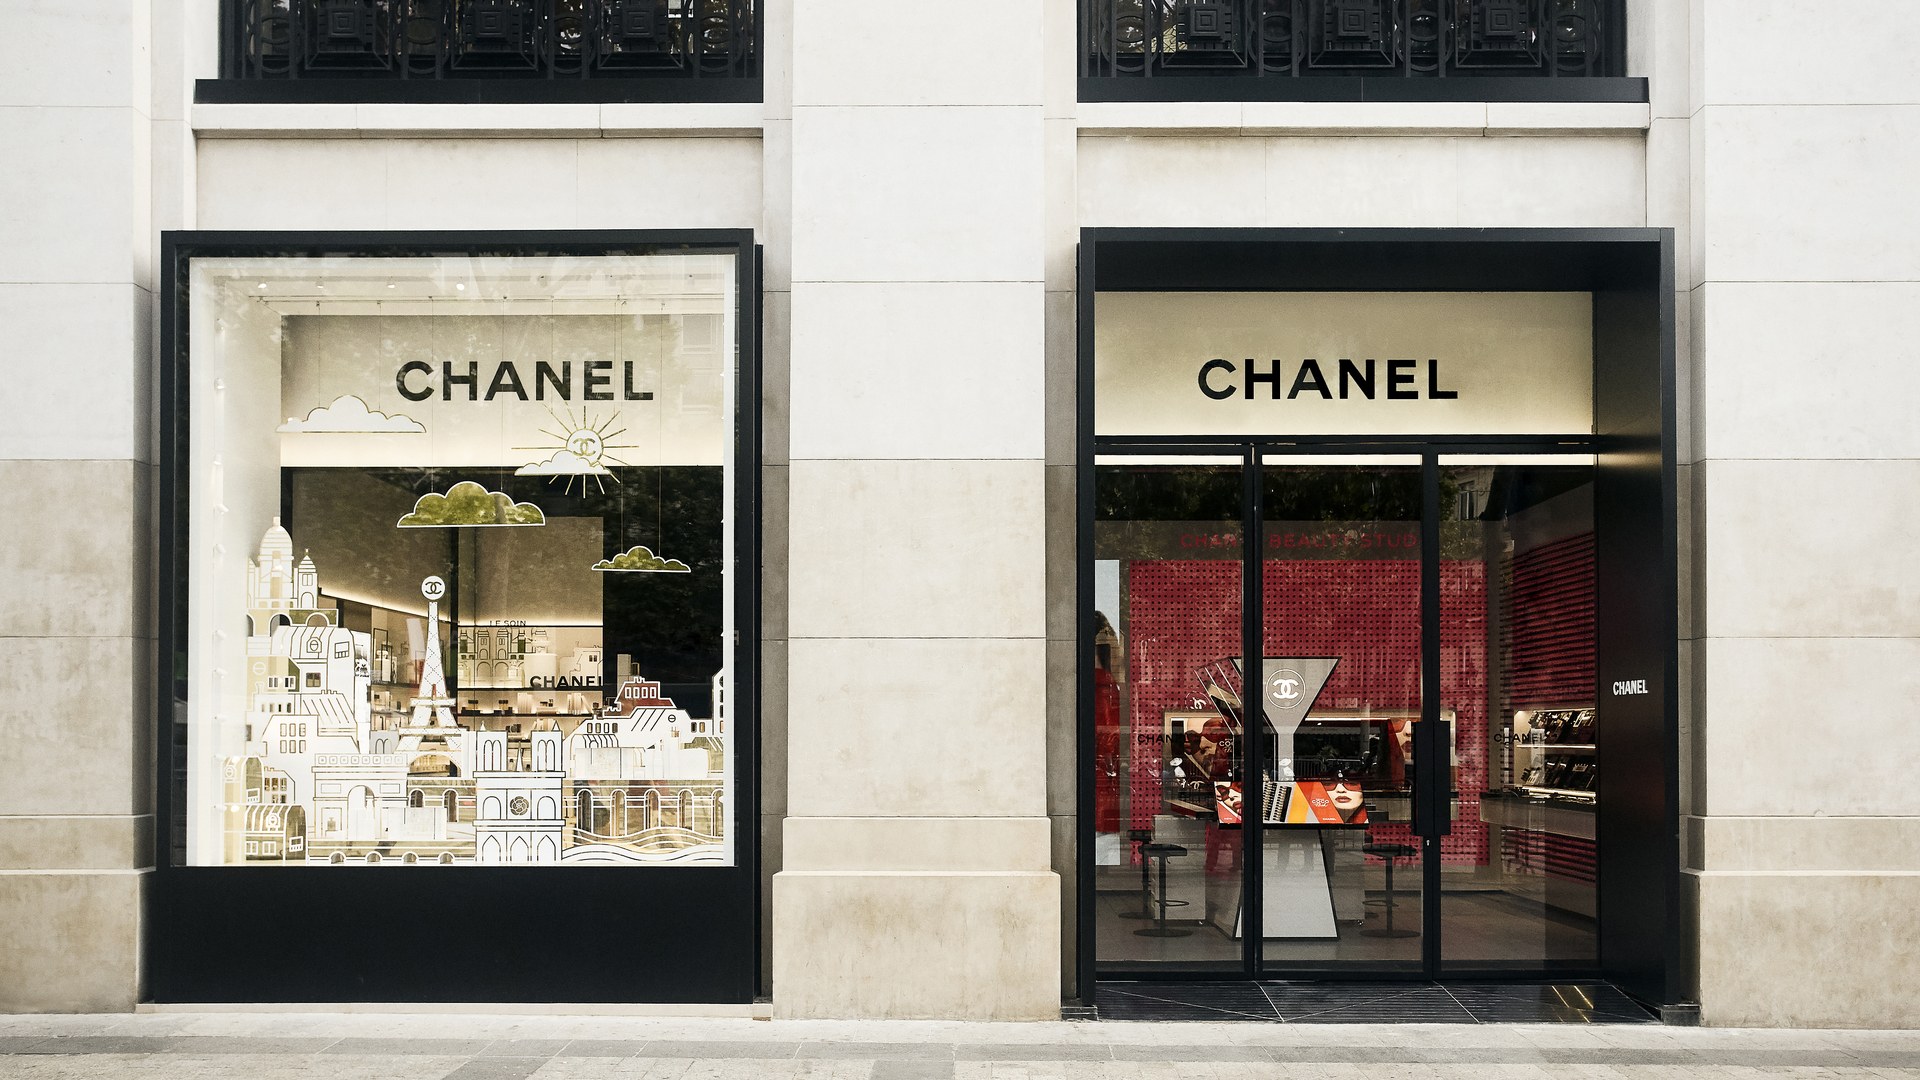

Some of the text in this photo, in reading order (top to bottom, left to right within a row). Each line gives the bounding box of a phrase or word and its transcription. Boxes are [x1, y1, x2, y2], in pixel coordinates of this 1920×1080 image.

[396, 360, 654, 402] CHANEL
[1198, 358, 1458, 400] CHANEL
[1181, 533, 1238, 548] CHAN
[1361, 533, 1417, 549] STUD
[1612, 679, 1648, 696] CHANEL
[1137, 734, 1173, 744] CHAN
